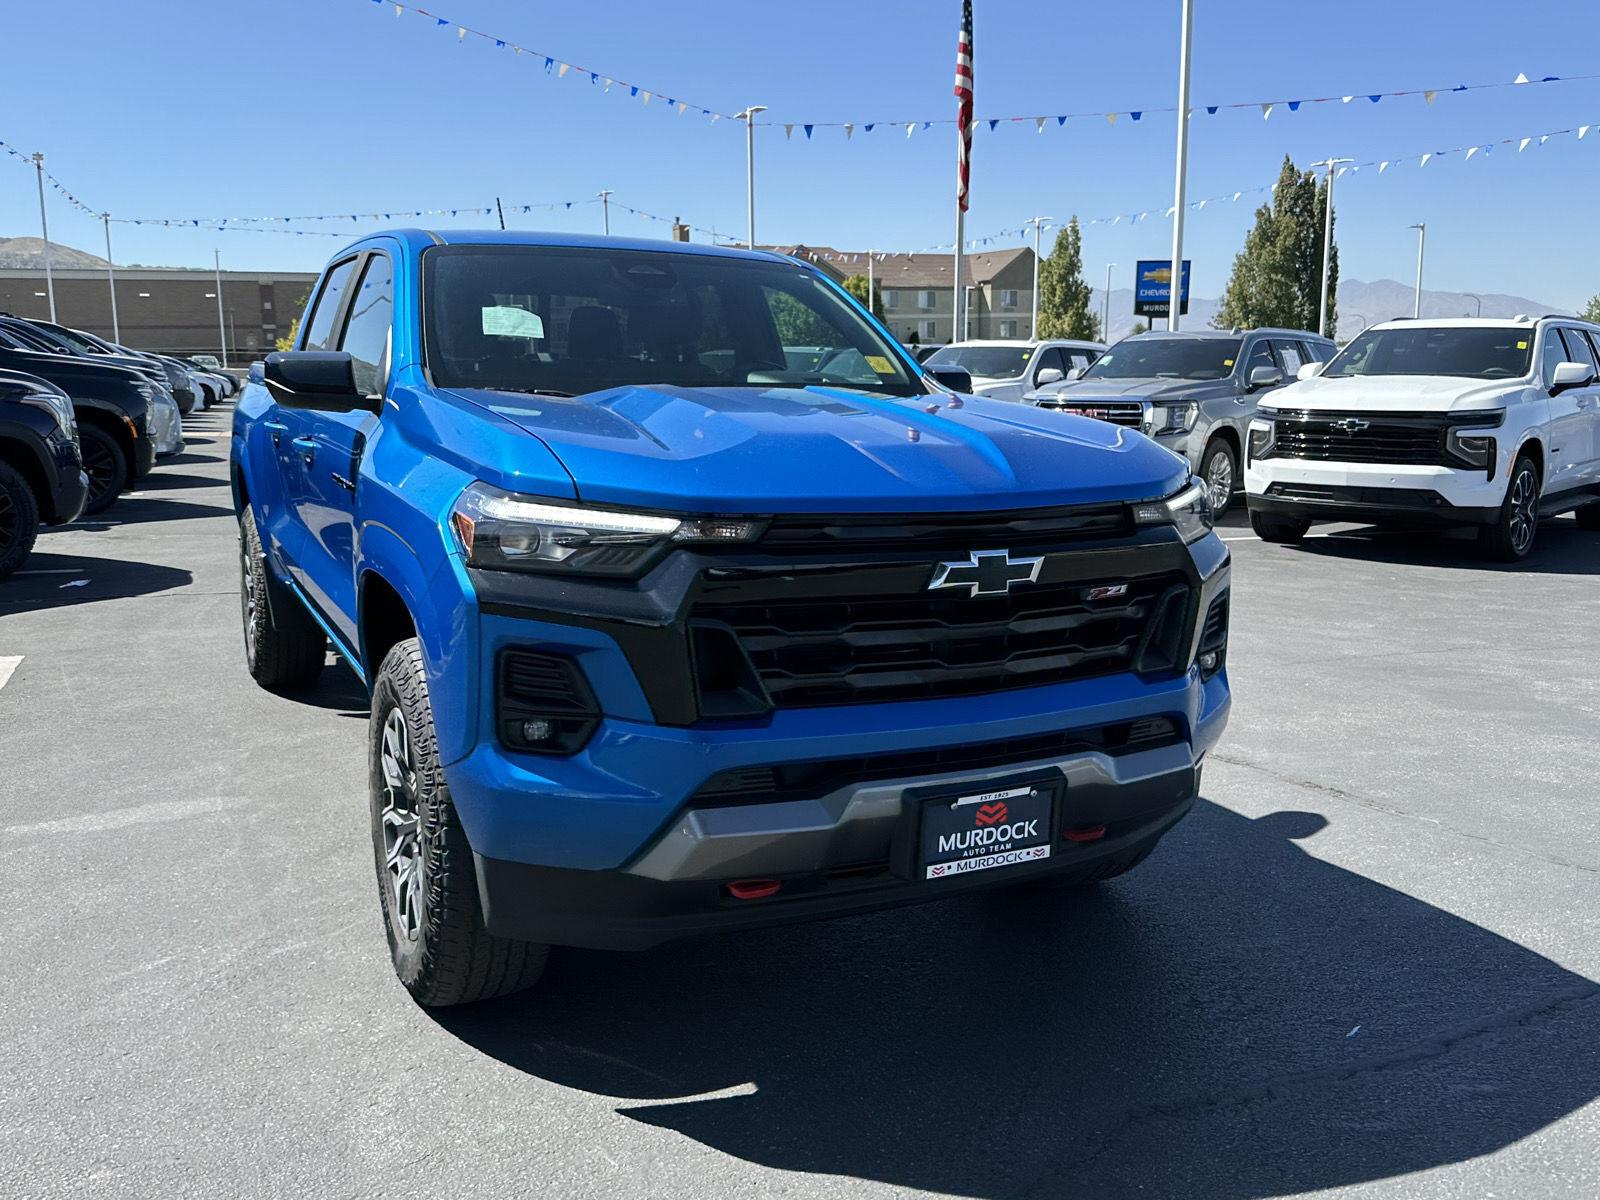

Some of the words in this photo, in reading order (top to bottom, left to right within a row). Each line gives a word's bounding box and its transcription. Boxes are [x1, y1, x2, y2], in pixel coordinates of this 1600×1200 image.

[1140, 288, 1184, 297] CHEVROT
[1143, 304, 1169, 312] MURDO
[1086, 584, 1128, 600] Z71
[938, 819, 1038, 853] MURDOCK
[963, 848, 986, 857] AUTO
[990, 843, 1012, 852] TEAM
[956, 851, 1024, 872] MURDOCK
